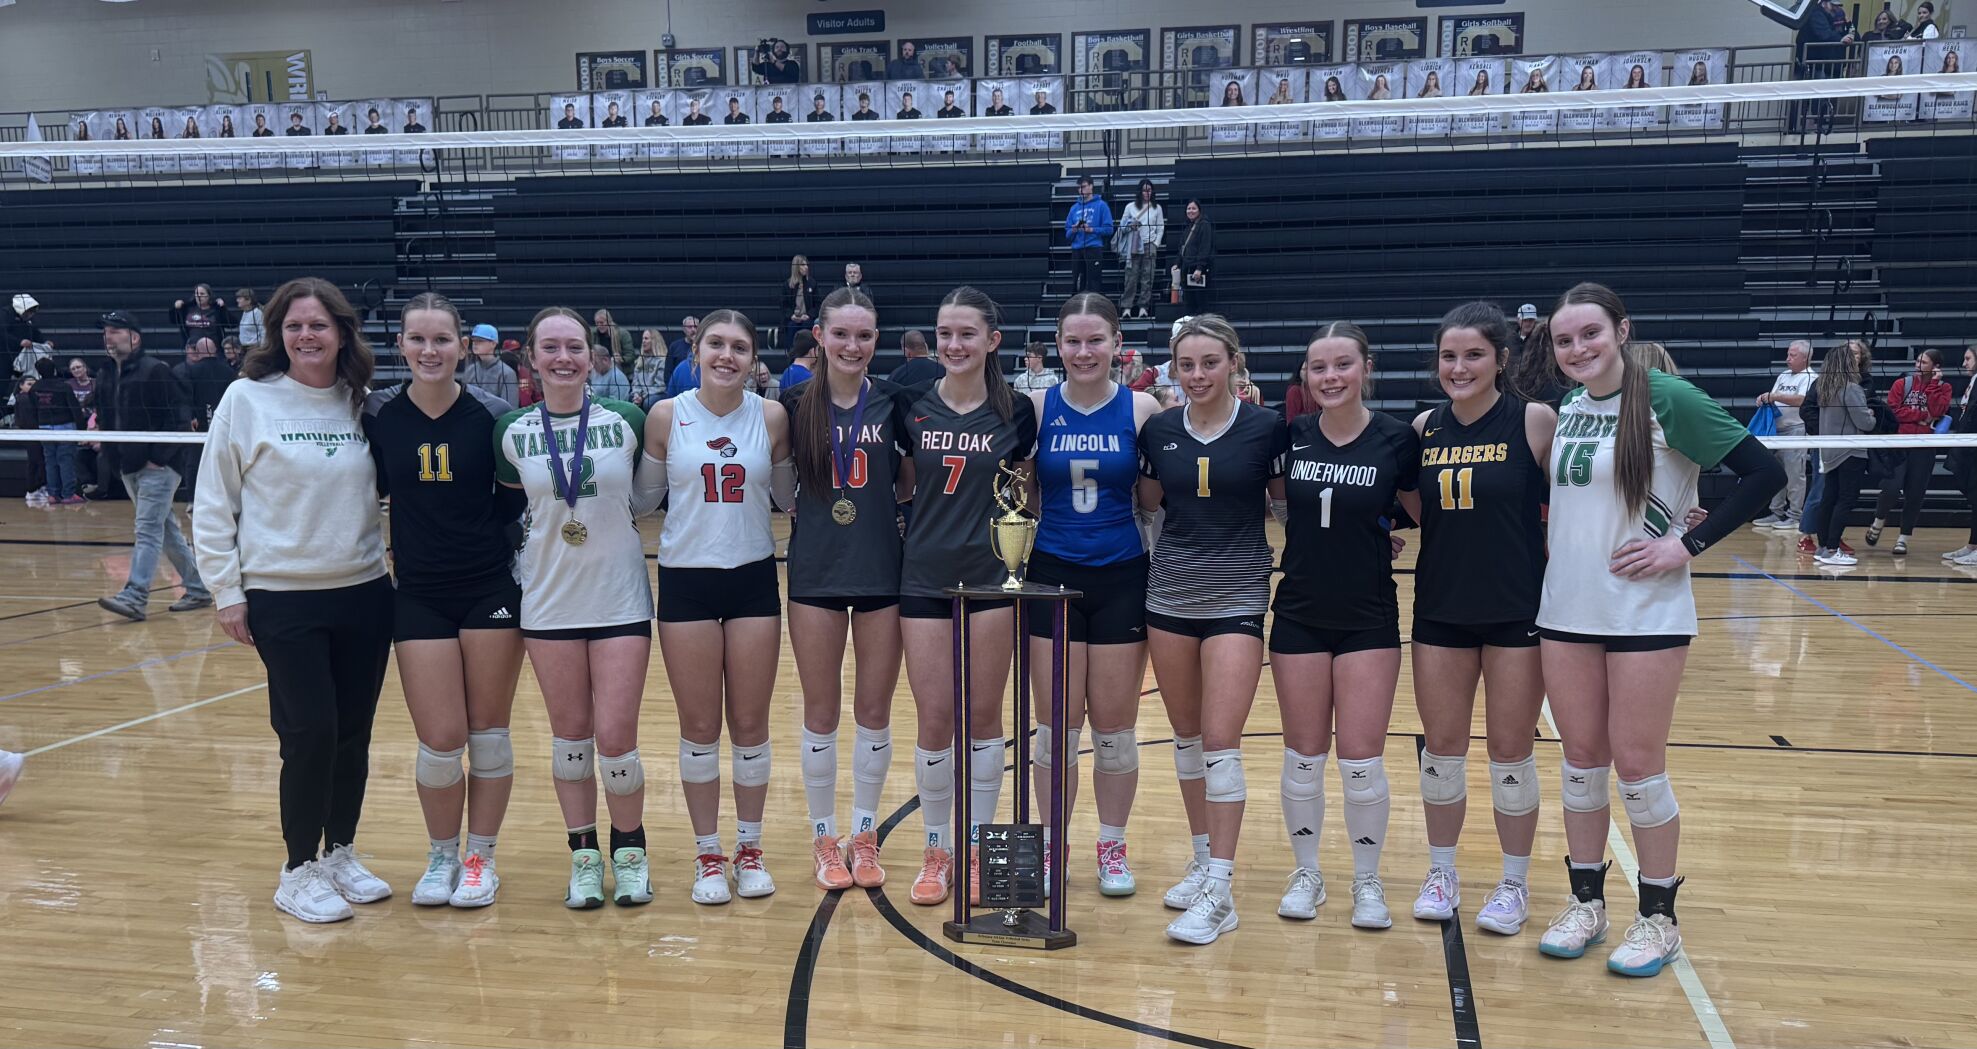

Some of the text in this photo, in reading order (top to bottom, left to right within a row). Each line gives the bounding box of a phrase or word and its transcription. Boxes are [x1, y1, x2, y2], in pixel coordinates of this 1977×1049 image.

[817, 18, 875, 28] Visitor Adults
[1177, 30, 1233, 39] Girls Basketba
[1281, 26, 1315, 34] Wrestling
[1385, 22, 1417, 31] Baseball
[1462, 18, 1512, 28] Girls Softball
[924, 42, 957, 51] Volleyball
[1107, 34, 1144, 42] Basketball
[1555, 411, 1618, 439] WARHAW
[921, 430, 993, 453] RED OAK
[1050, 434, 1120, 453] LINCOLN
[1421, 442, 1508, 467] CHARGERS
[417, 443, 453, 481] 11
[942, 455, 966, 495] 7
[1290, 459, 1377, 487] UNDERWOOD
[1556, 441, 1600, 487] 15
[546, 455, 597, 501] 12
[700, 462, 746, 503] 12
[1069, 459, 1100, 514] 5
[1197, 456, 1211, 497] 1
[1437, 467, 1474, 510] 11
[1318, 487, 1334, 529] 1
